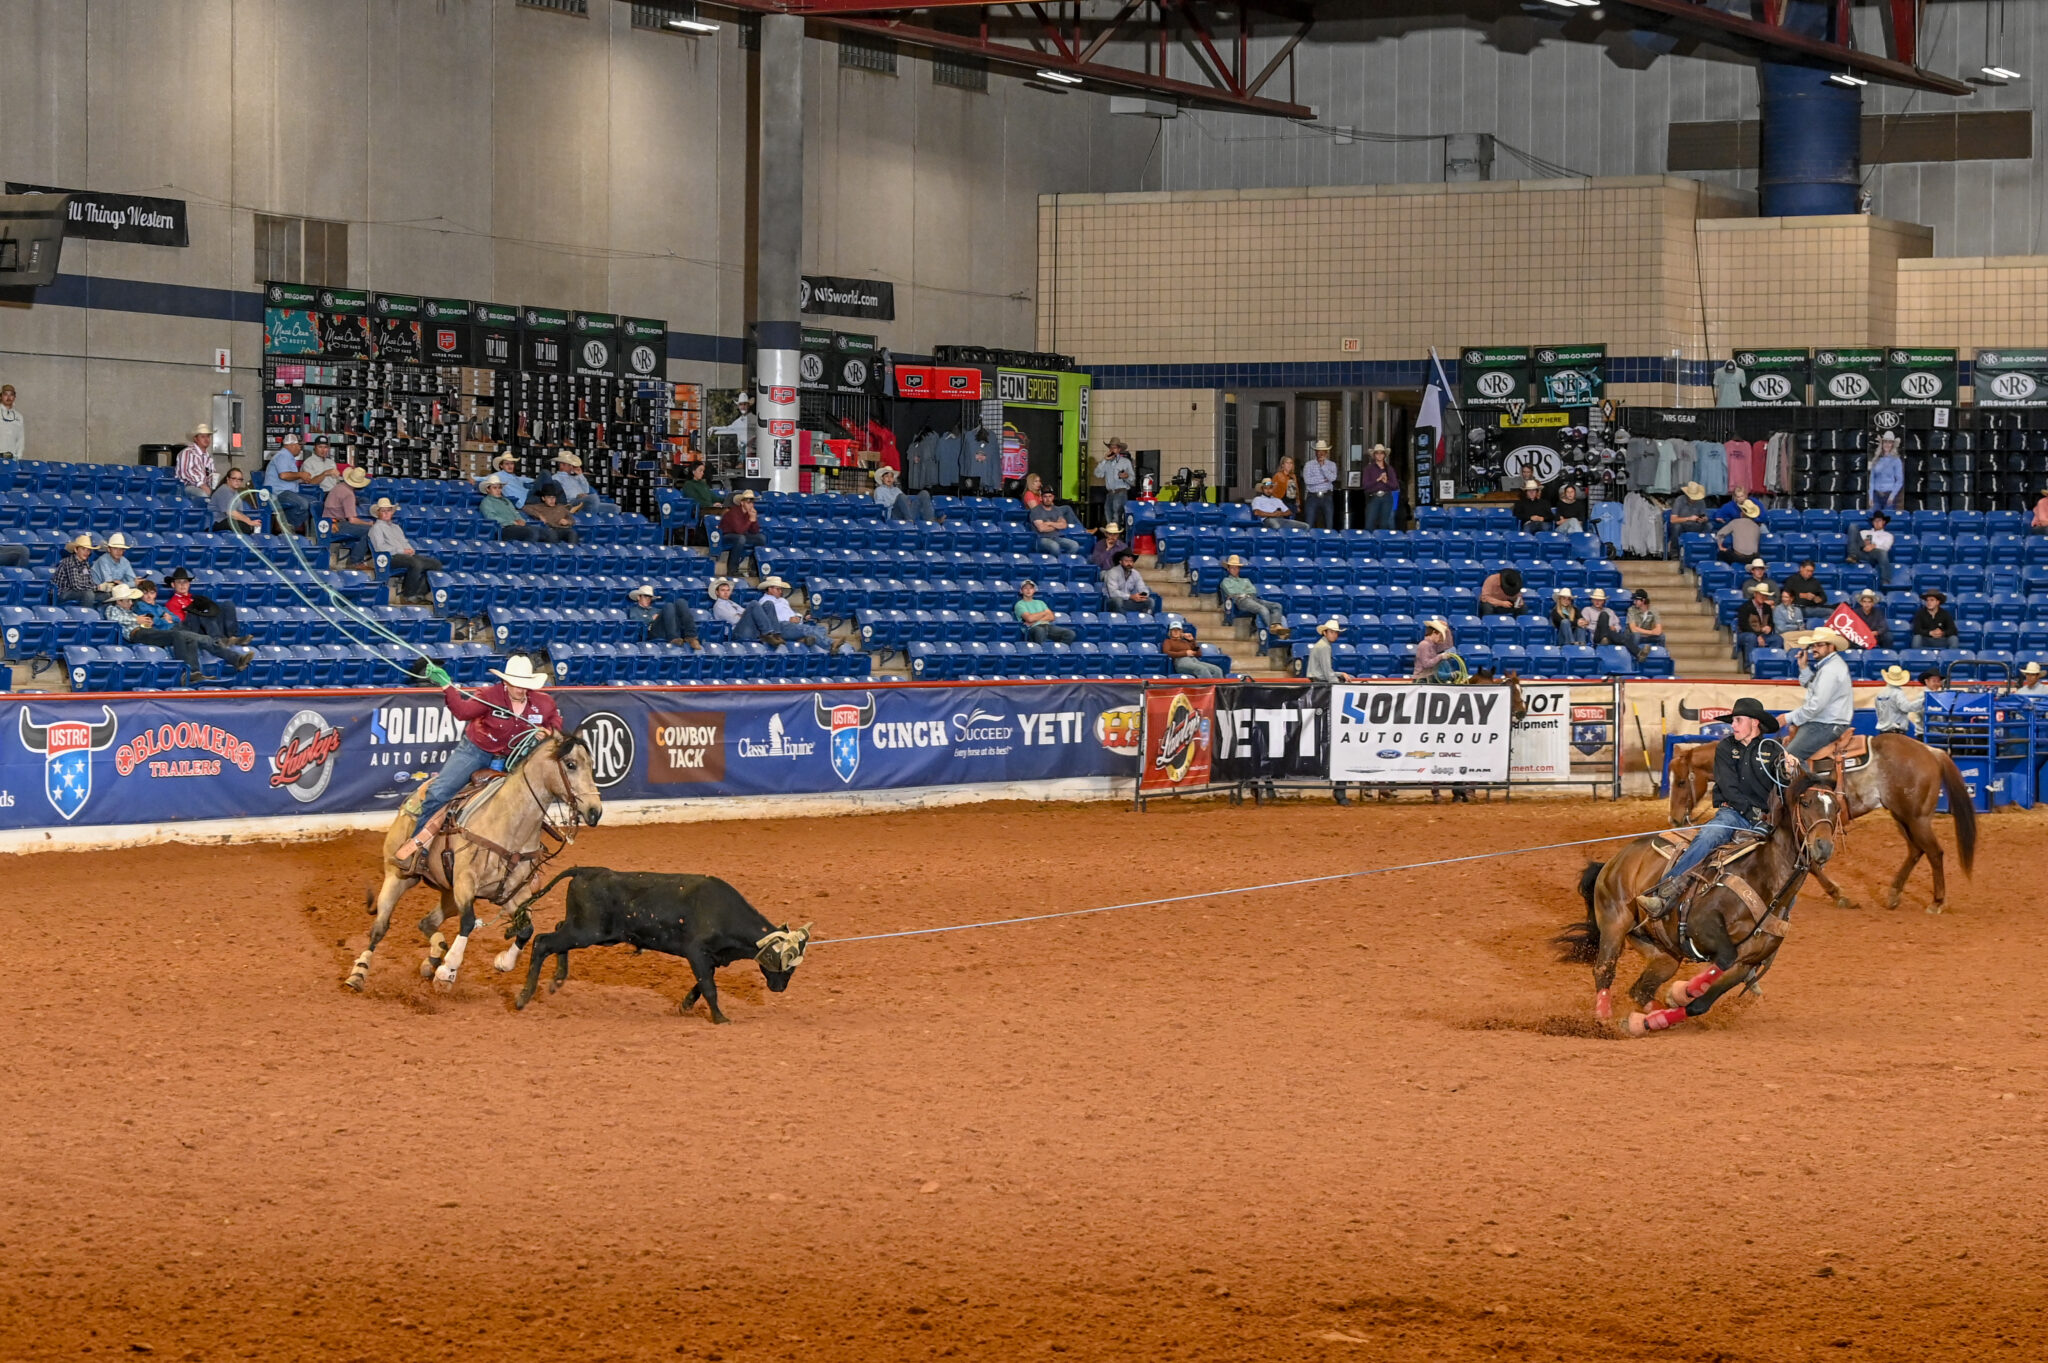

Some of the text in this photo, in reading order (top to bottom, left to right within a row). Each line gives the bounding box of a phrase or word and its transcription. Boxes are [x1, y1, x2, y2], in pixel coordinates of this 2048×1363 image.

[85, 202, 126, 230] Things
[127, 206, 174, 230] Western
[588, 343, 604, 365] NRS
[1344, 339, 1358, 350] EXIT
[636, 349, 652, 370] NRS
[1467, 352, 1482, 364] NRS
[1541, 351, 1555, 362] NRS
[1739, 353, 1755, 365] NRS
[1819, 353, 1835, 365] NRS
[1892, 351, 1907, 364] NRS
[1983, 353, 1998, 365] NRS
[803, 357, 819, 377] NRS
[847, 363, 863, 382] NRS
[1000, 375, 1057, 401] EQN SPORTS
[1483, 375, 1508, 394] NRS
[1758, 377, 1784, 396] NRS
[1836, 376, 1862, 395] NRS
[1908, 375, 1935, 394] NRS
[1999, 376, 2028, 396] NRS
[1468, 397, 1525, 405] NRSworld.com
[1741, 400, 1802, 408] NRSworld.com
[1891, 398, 1953, 406] NRSworld.com
[1662, 414, 1696, 423] NRS GEAR
[1878, 411, 1896, 428] NRS
[1513, 450, 1552, 479] NRS
[833, 710, 858, 725] USTRC
[1340, 692, 1499, 726] HOLIDAY
[1574, 708, 1604, 719] USTRC
[370, 706, 466, 745] HOLIDAY
[872, 720, 949, 749] CINCH
[1017, 711, 1083, 746] YETI
[1216, 708, 1317, 760] YETI
[51, 728, 88, 746] USTRC
[131, 722, 241, 765] BLOOMER
[655, 726, 717, 747] COWBOY
[1340, 732, 1499, 744] AUTO GROUP
[582, 719, 625, 778] NRS
[738, 736, 815, 760] Classic Equine
[1380, 750, 1397, 758] Ford
[370, 750, 452, 766] AUTO GRO
[668, 748, 705, 768] TACK
[150, 760, 221, 777] TRAILERS
[1431, 765, 1455, 775] Jeep
